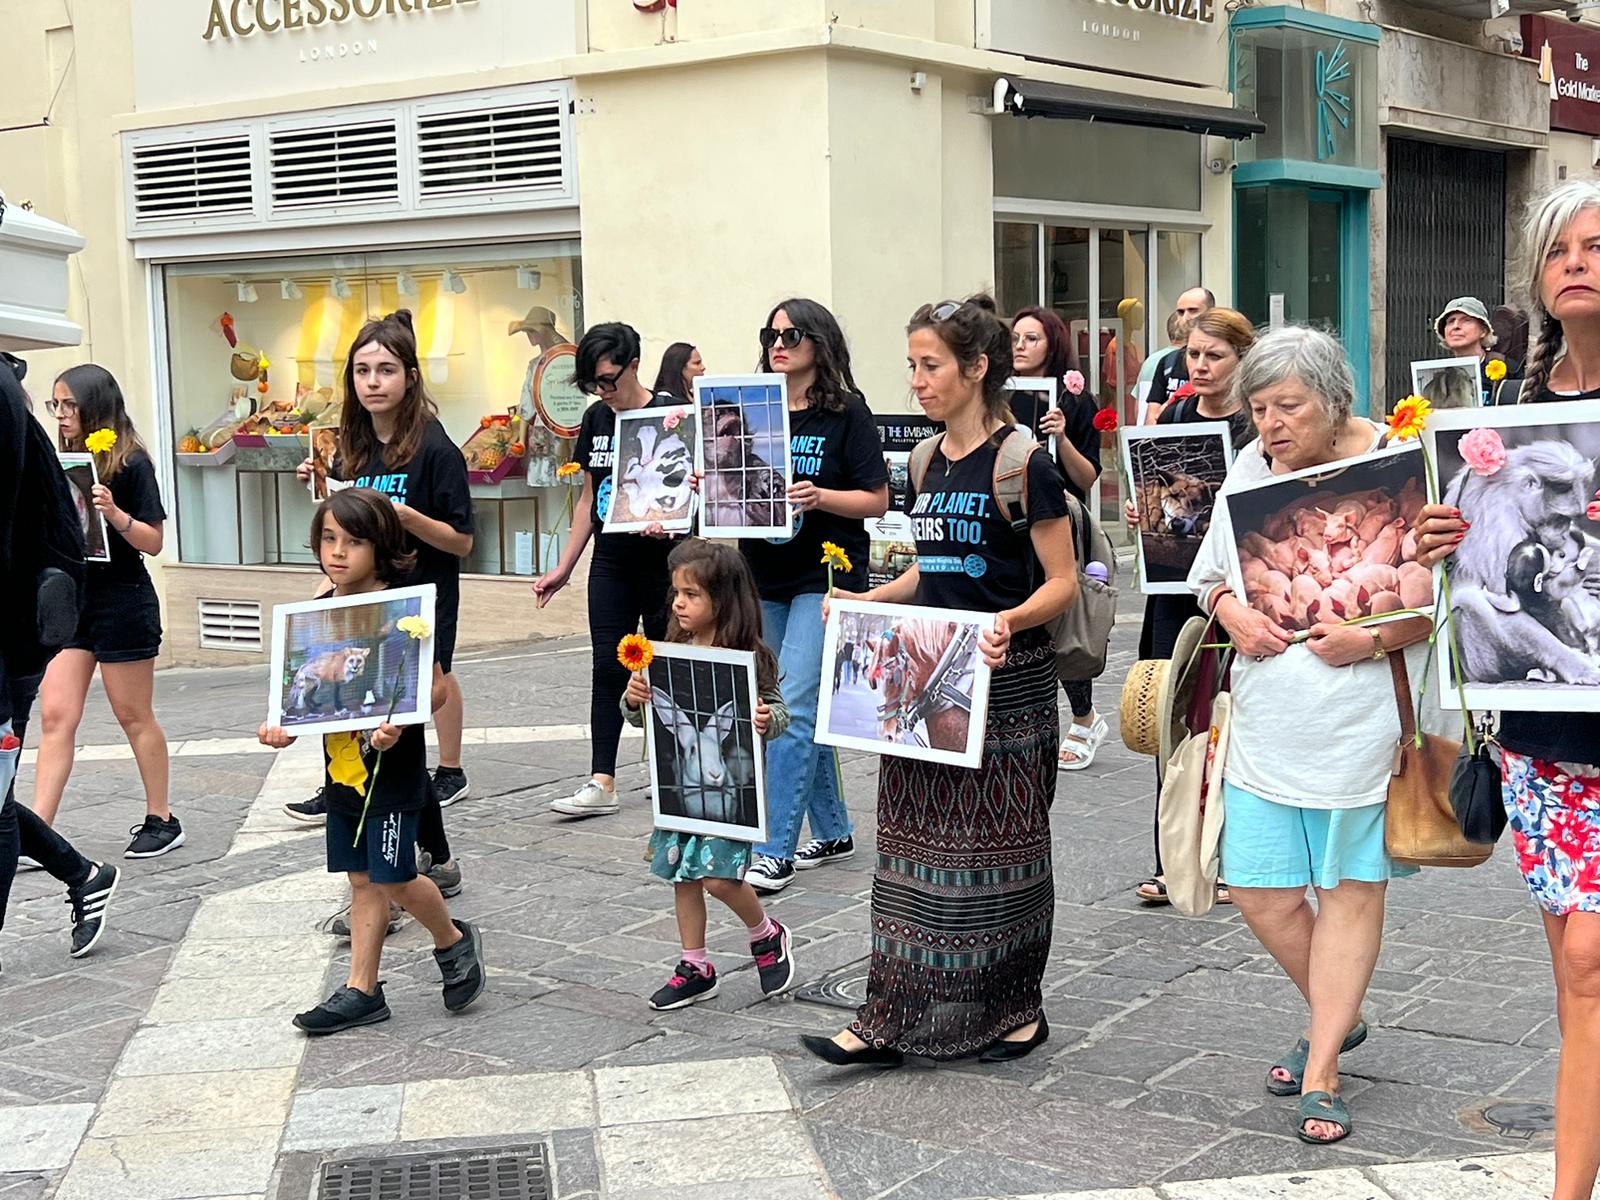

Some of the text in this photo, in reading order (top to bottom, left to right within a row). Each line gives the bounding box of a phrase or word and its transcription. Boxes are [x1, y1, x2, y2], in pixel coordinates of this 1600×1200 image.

[202, 0, 480, 40] ACCESS
[1082, 20, 1141, 42] LONDON
[299, 39, 378, 63] LONDON
[1575, 52, 1589, 71] The
[1558, 77, 1577, 98] Gold
[887, 426, 902, 438] THE
[790, 435, 826, 456] ANET,
[912, 517, 944, 541] EIRS
